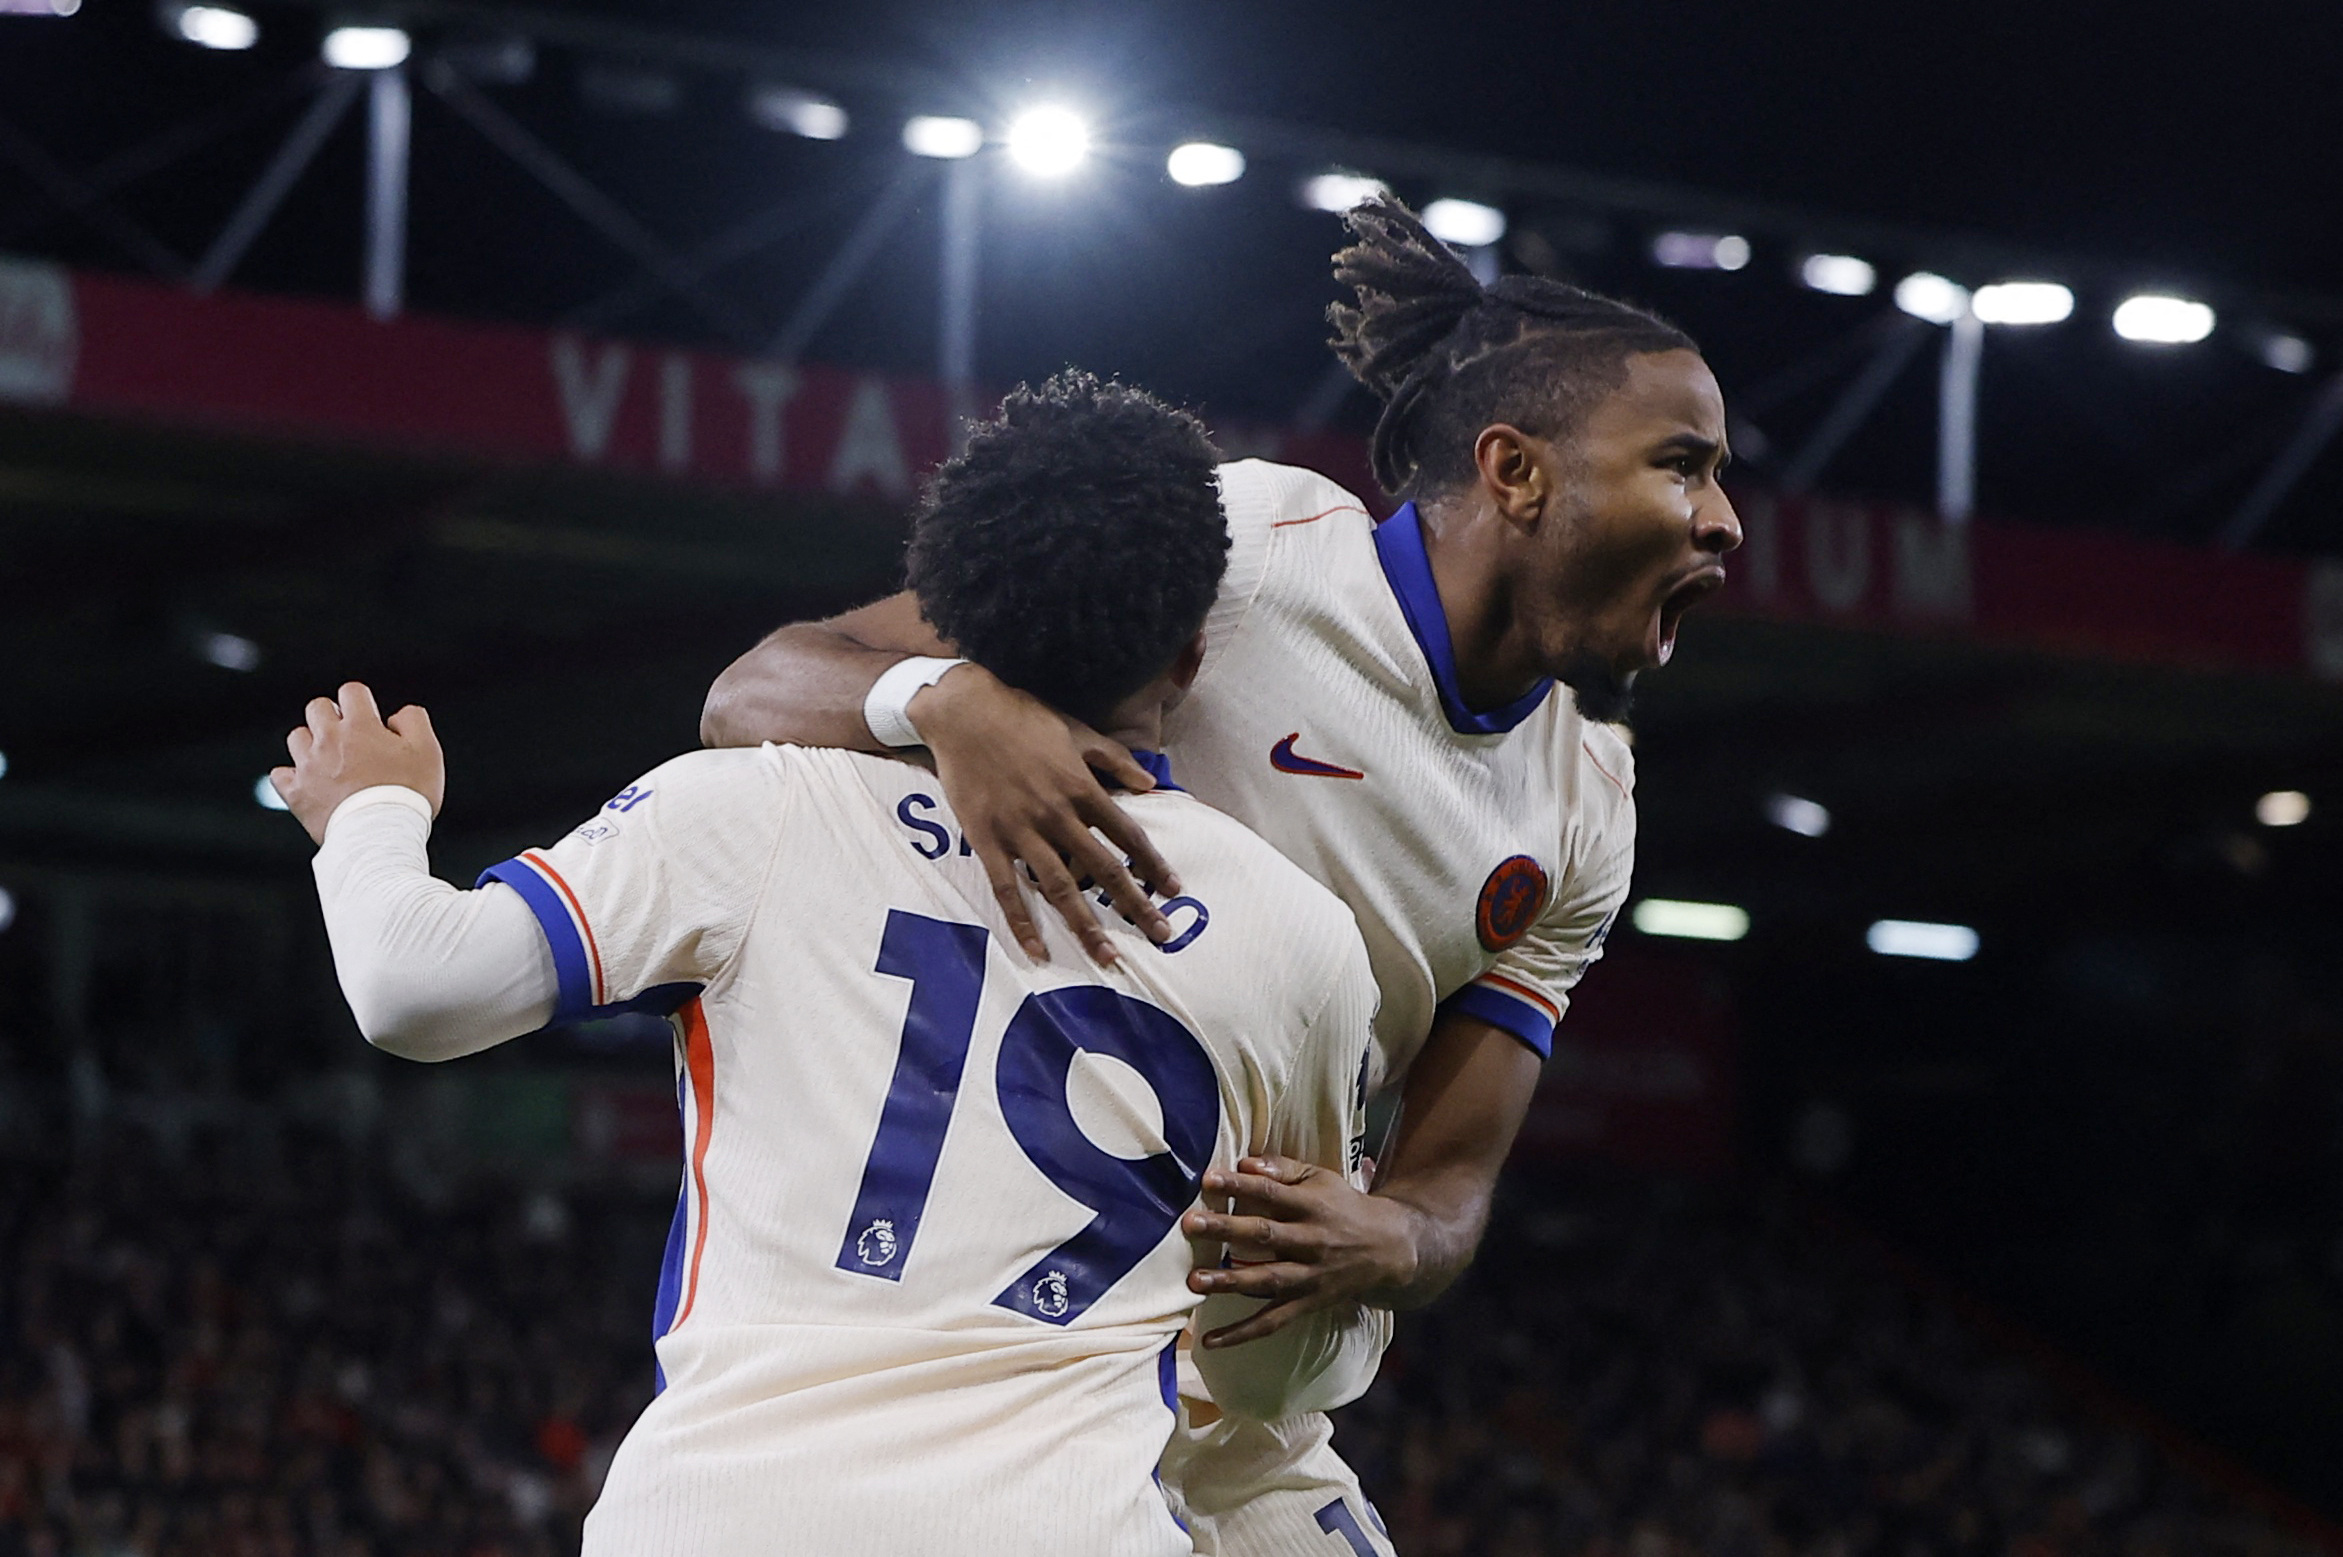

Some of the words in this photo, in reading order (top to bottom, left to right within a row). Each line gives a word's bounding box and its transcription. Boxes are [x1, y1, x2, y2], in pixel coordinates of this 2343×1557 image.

[547, 336, 918, 502] VITA
[1743, 494, 1977, 622] IUM
[834, 907, 1221, 1328] 19
[1313, 1495, 1389, 1557] 1
